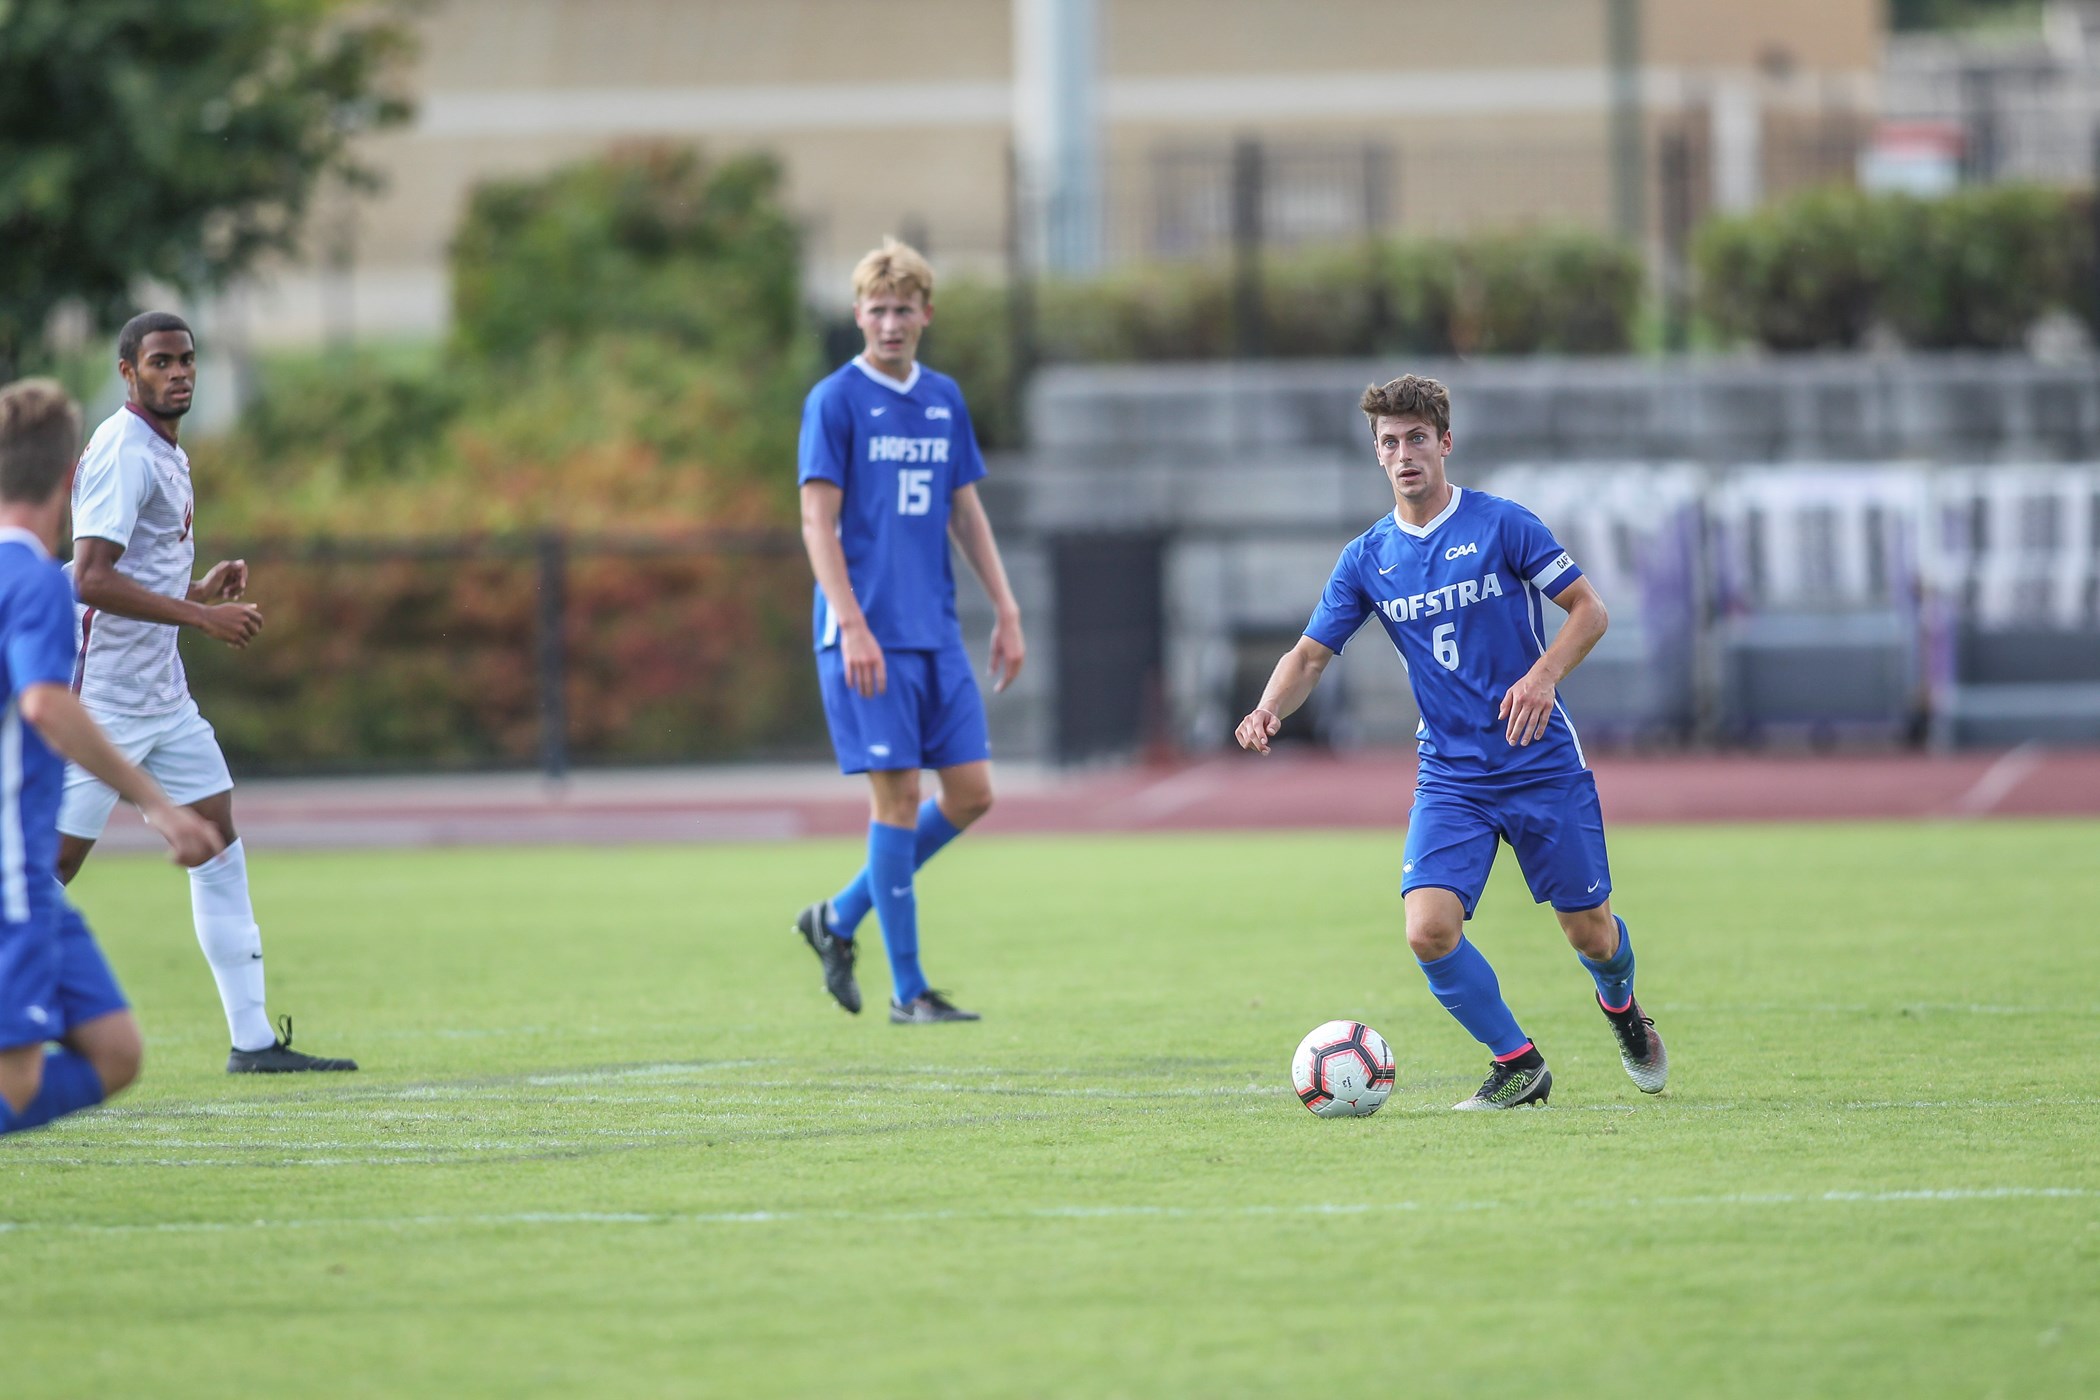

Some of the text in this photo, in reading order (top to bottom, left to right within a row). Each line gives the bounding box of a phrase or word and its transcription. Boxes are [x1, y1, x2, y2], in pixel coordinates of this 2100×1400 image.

[869, 436, 950, 463] HOFSTR
[898, 469, 932, 516] 15
[1445, 542, 1478, 560] CAA
[1433, 622, 1460, 671] 6
